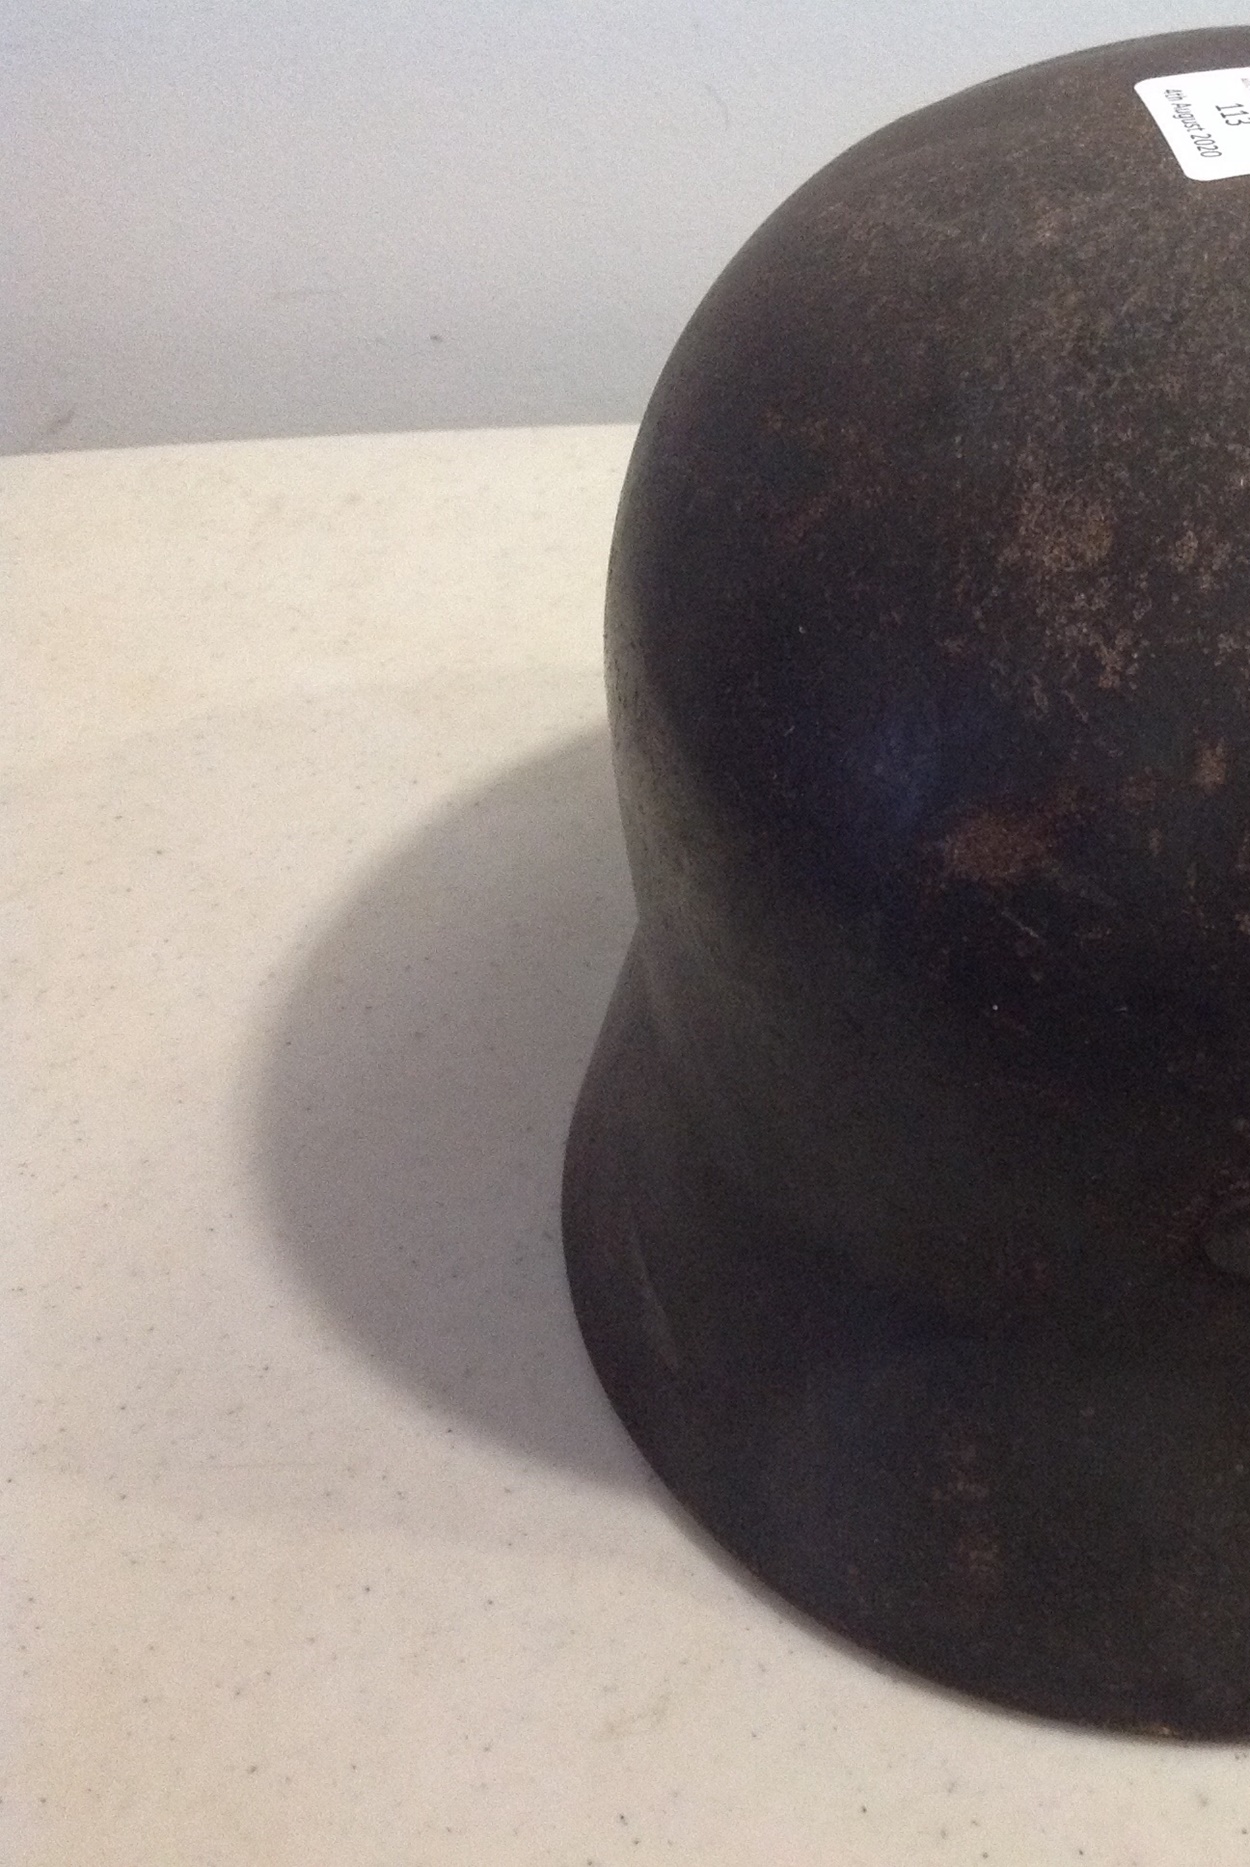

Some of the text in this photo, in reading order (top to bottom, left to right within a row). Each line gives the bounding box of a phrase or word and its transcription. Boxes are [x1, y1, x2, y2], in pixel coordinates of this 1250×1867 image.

[1165, 88, 1222, 158] 4th August 2020
